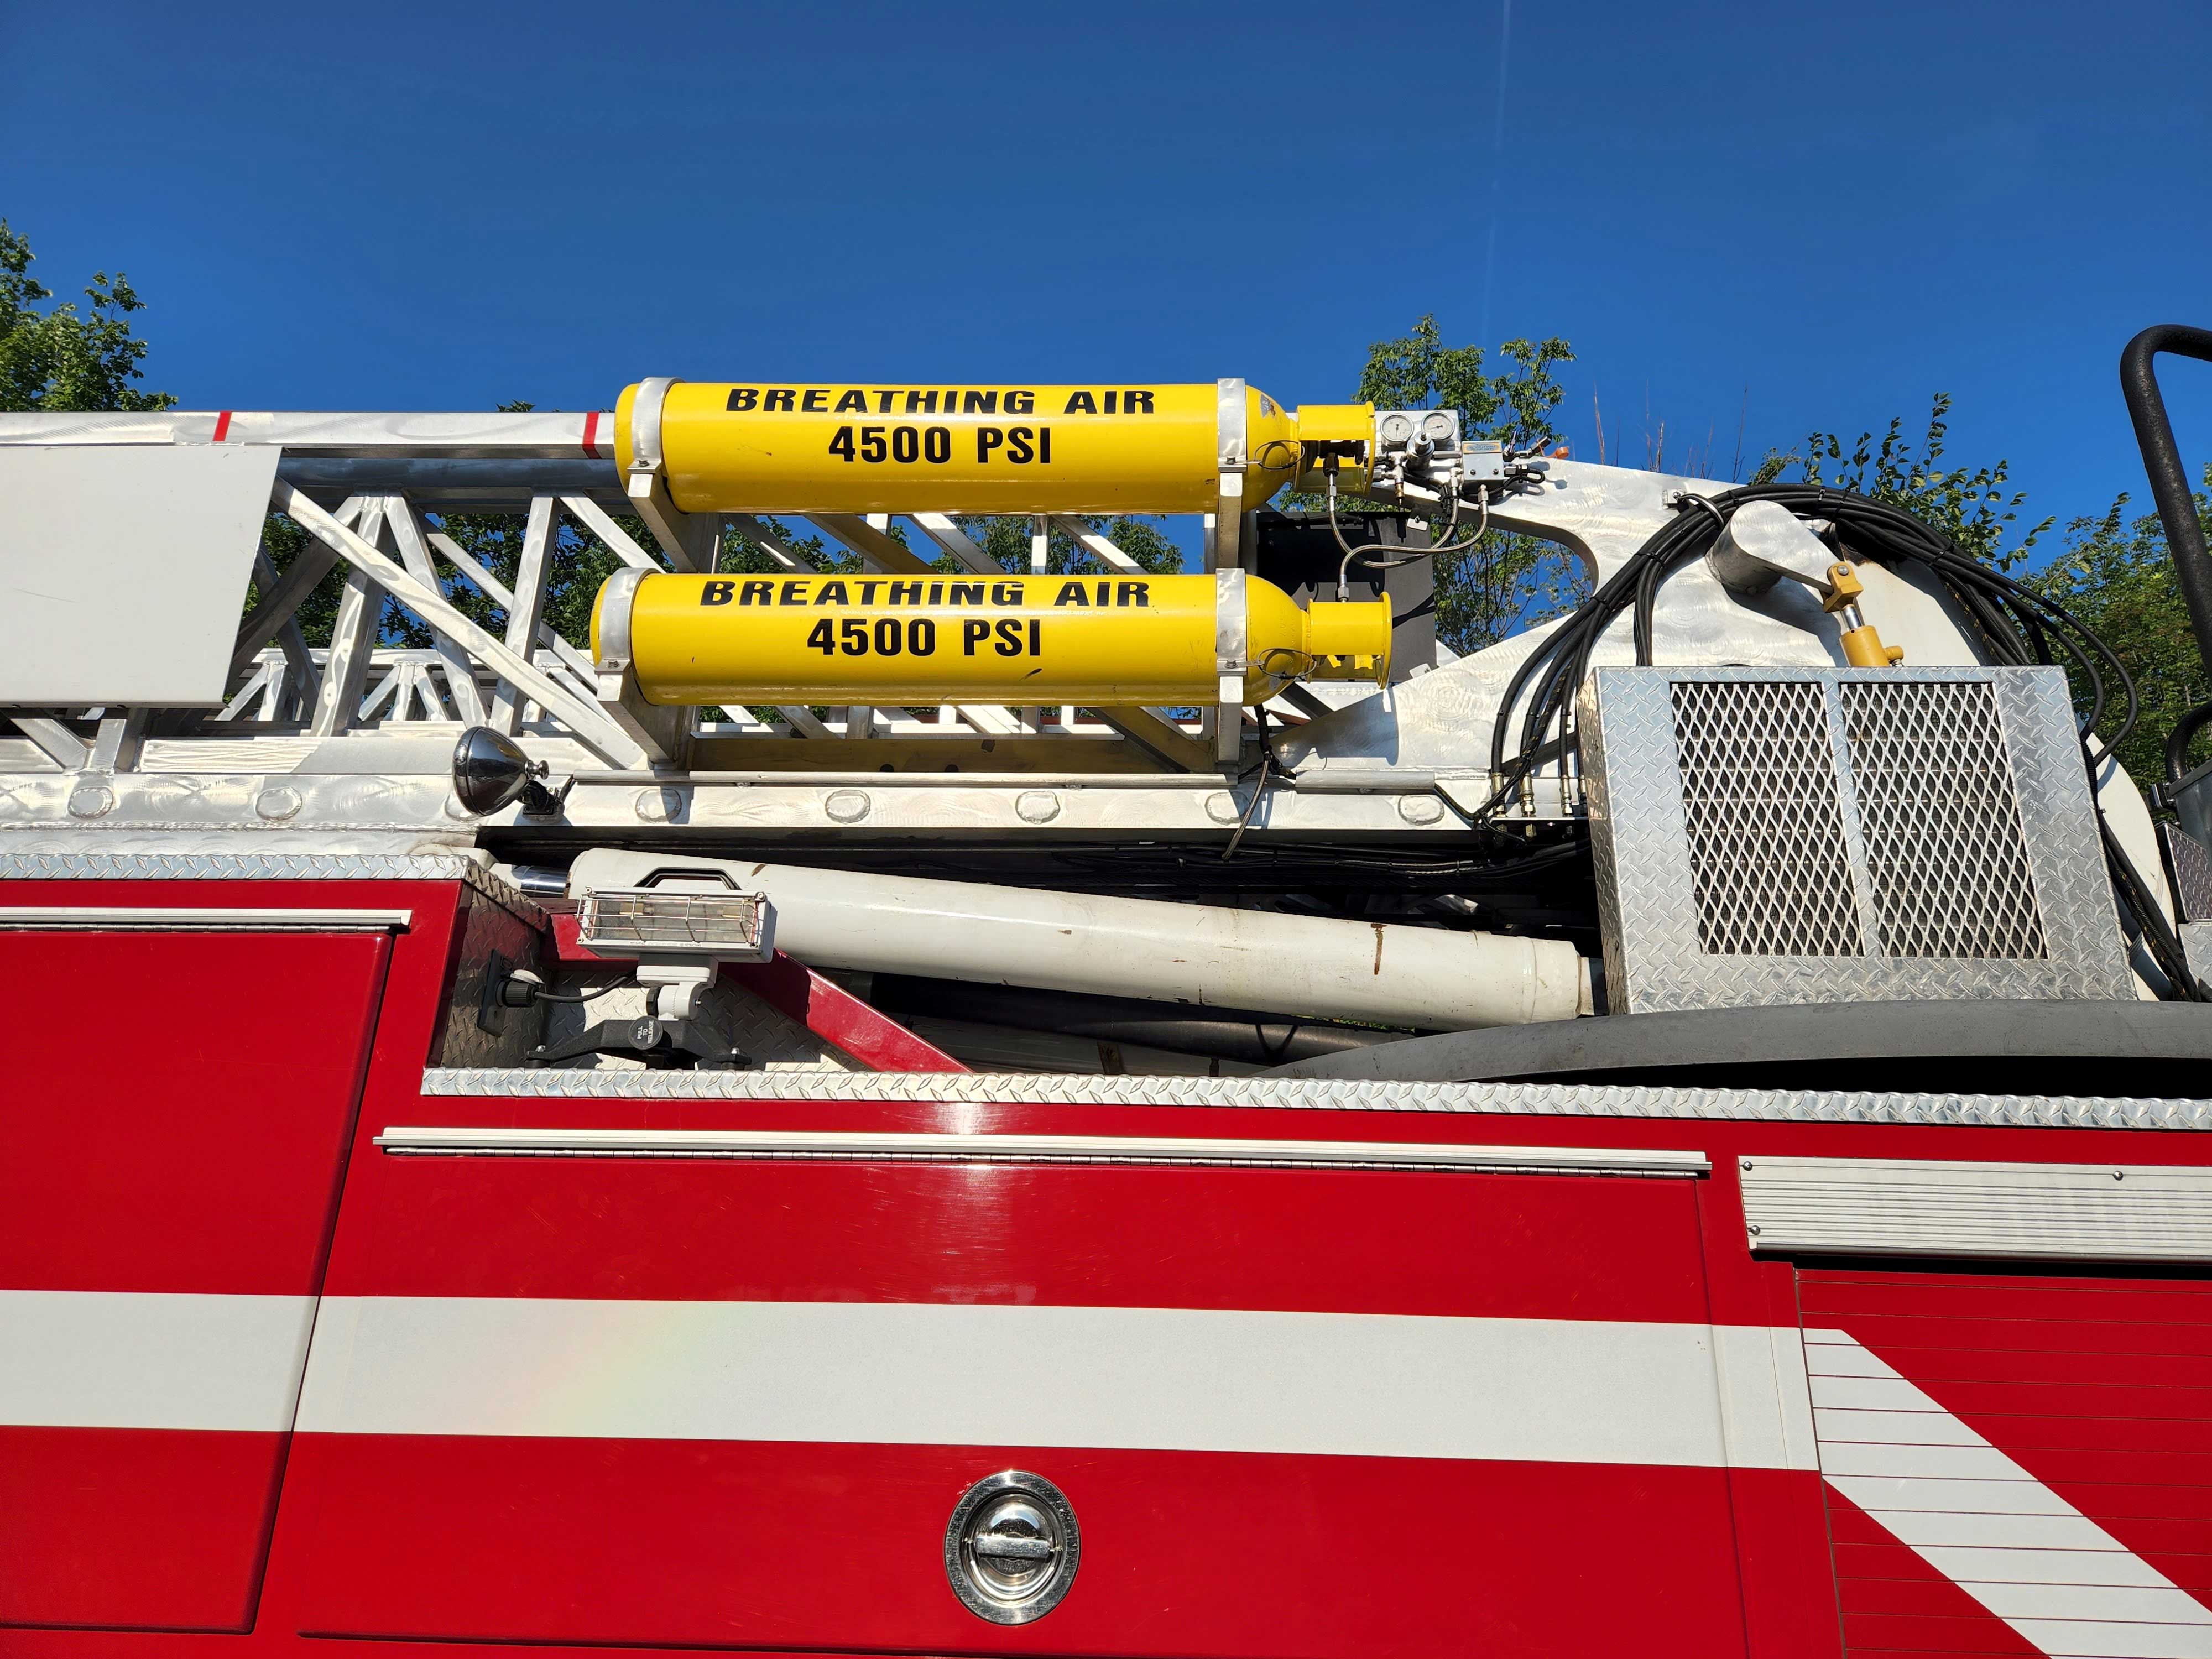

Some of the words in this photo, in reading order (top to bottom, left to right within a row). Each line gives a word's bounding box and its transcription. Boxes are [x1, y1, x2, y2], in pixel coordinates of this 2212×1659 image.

[726, 389, 1035, 414] BREATHING
[1064, 390, 1154, 414] AIR
[828, 426, 951, 463] 4500
[977, 427, 1051, 464] PSI
[701, 581, 1023, 606] BREATHING
[1054, 582, 1149, 607] AIR
[807, 618, 935, 656] 4500
[963, 619, 1040, 657] PSI
